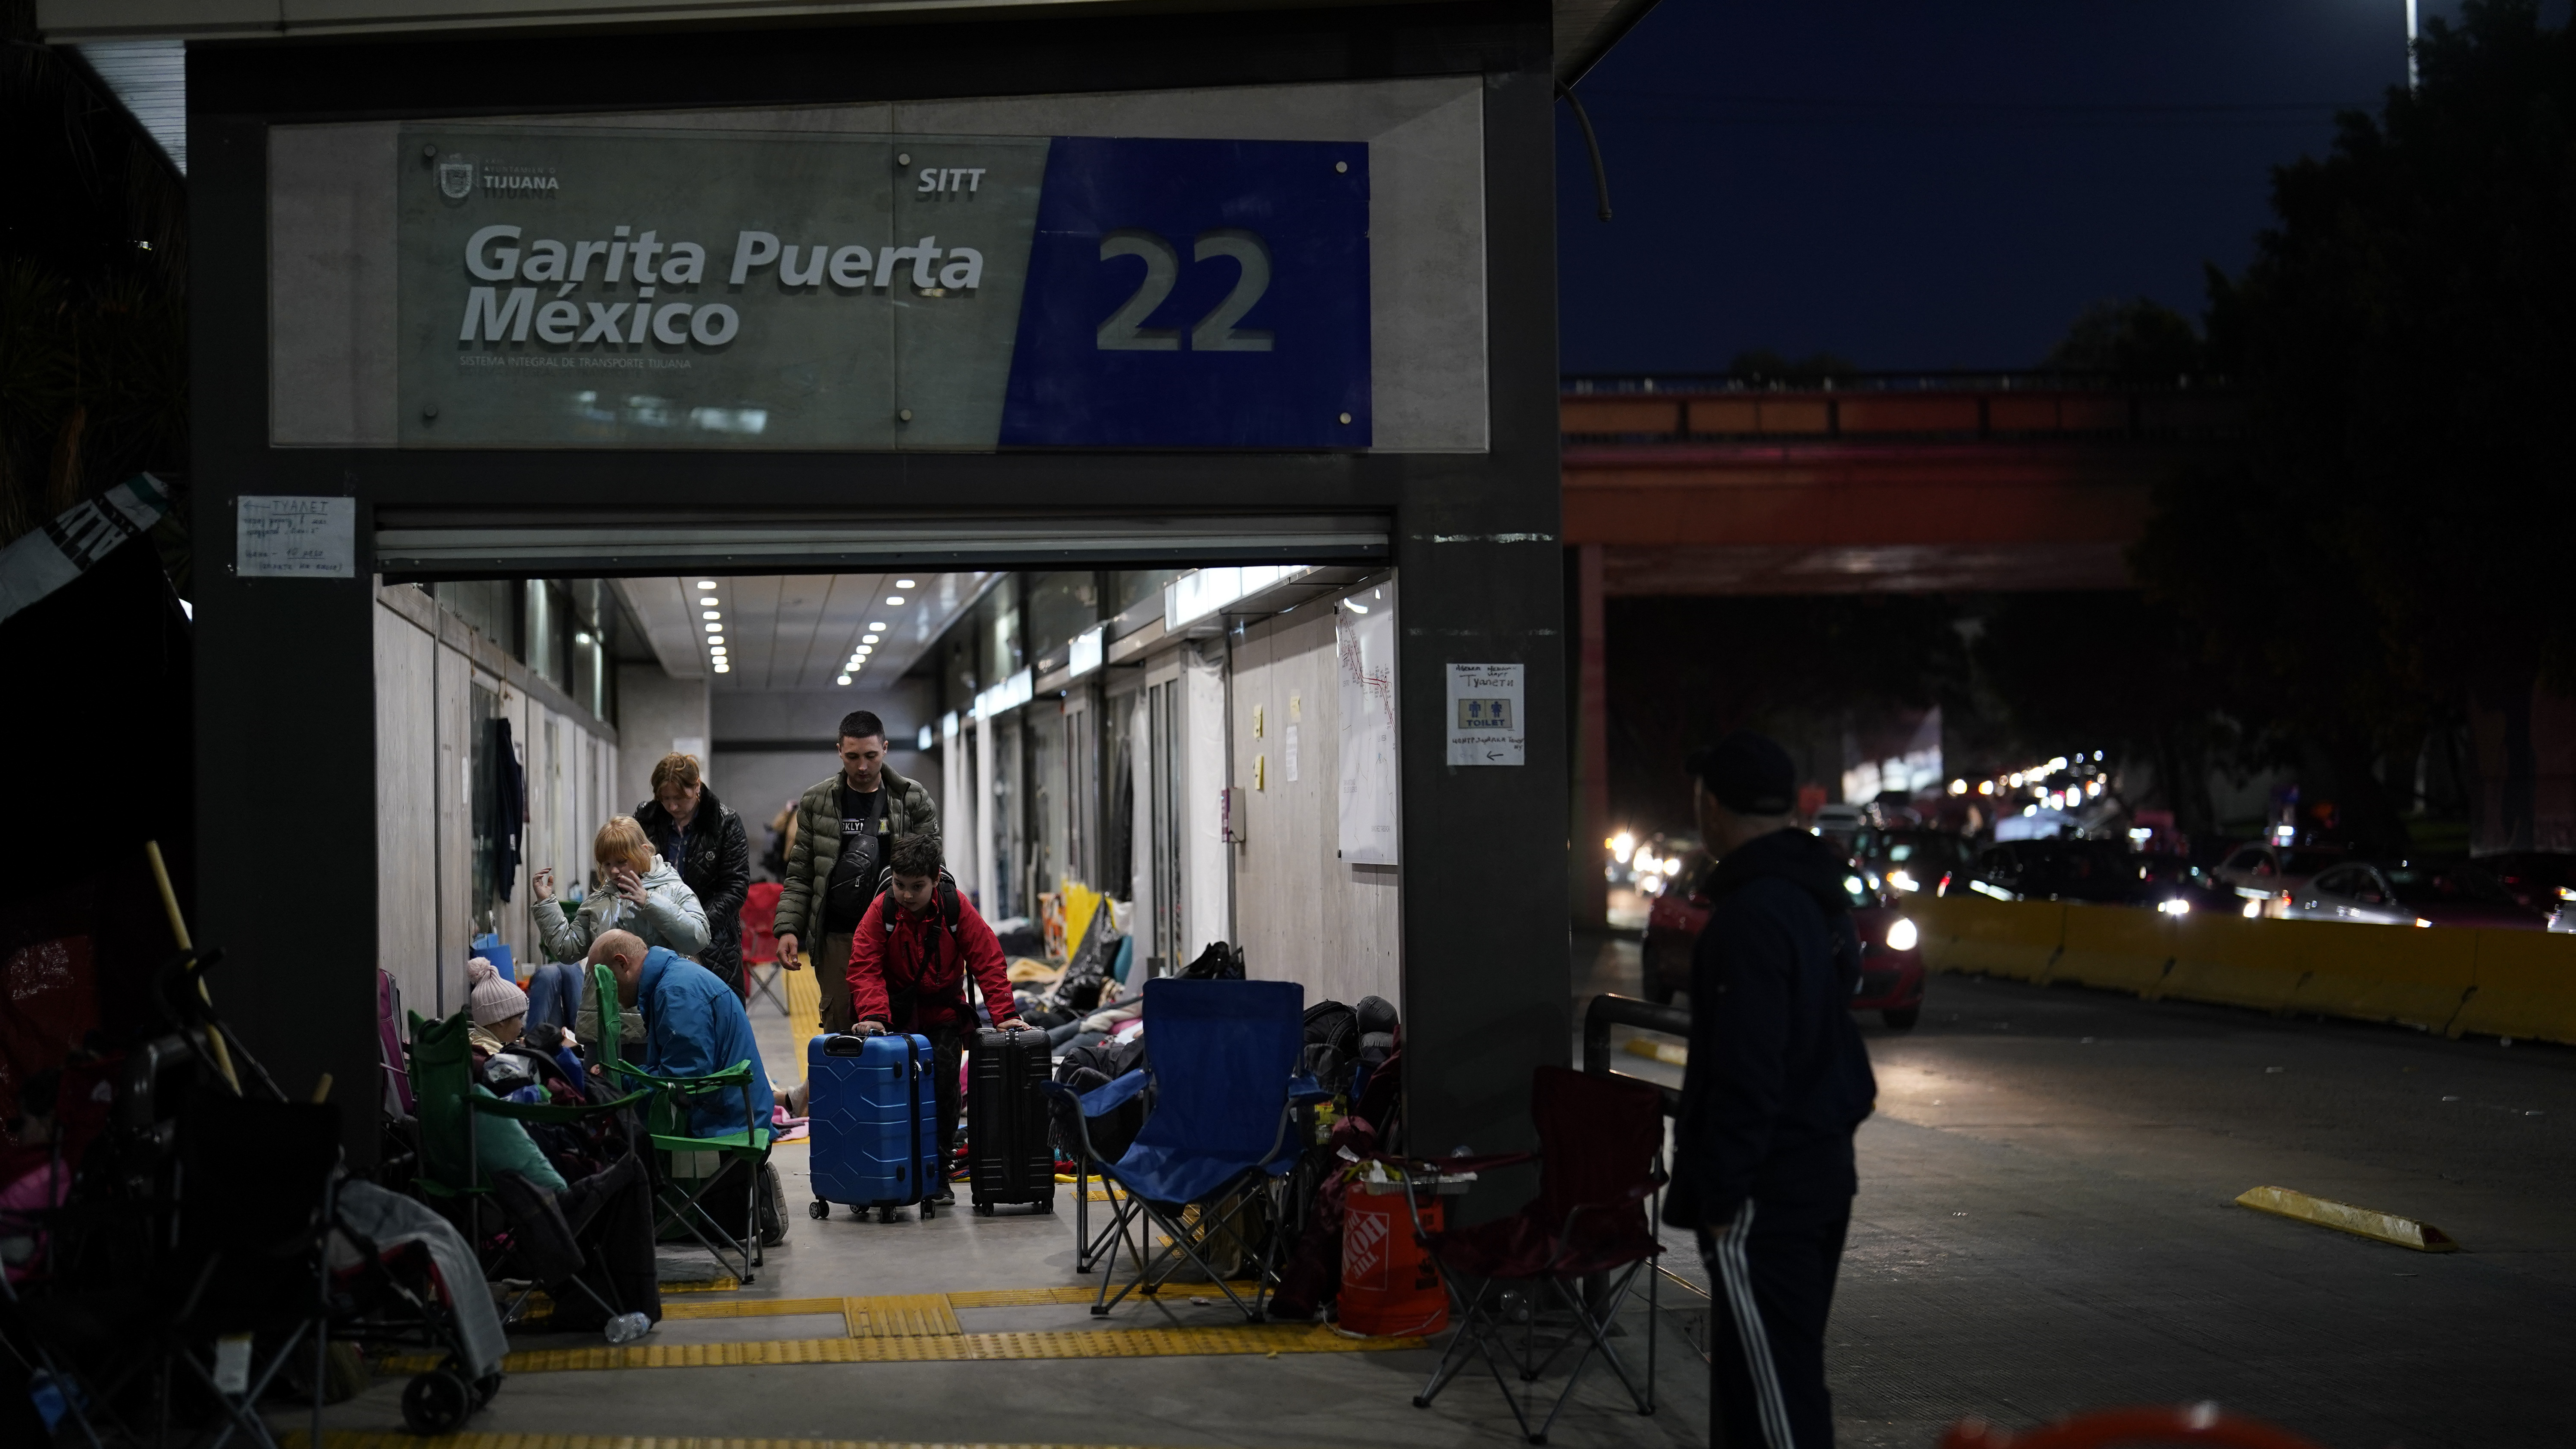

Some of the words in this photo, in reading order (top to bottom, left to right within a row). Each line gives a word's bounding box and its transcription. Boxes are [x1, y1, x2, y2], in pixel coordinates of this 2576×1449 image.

[484, 176, 559, 189] TIJUANA
[917, 168, 986, 192] SITT
[465, 225, 706, 283] Garita
[729, 230, 984, 290] Puerta
[1096, 230, 1275, 352] 22
[459, 283, 740, 345] México
[460, 356, 504, 366] SISTEMA
[508, 356, 558, 367] INTEGRAL
[562, 357, 574, 367] DE
[579, 357, 644, 368] TRANSPORTE
[648, 358, 692, 369] TIJUANA
